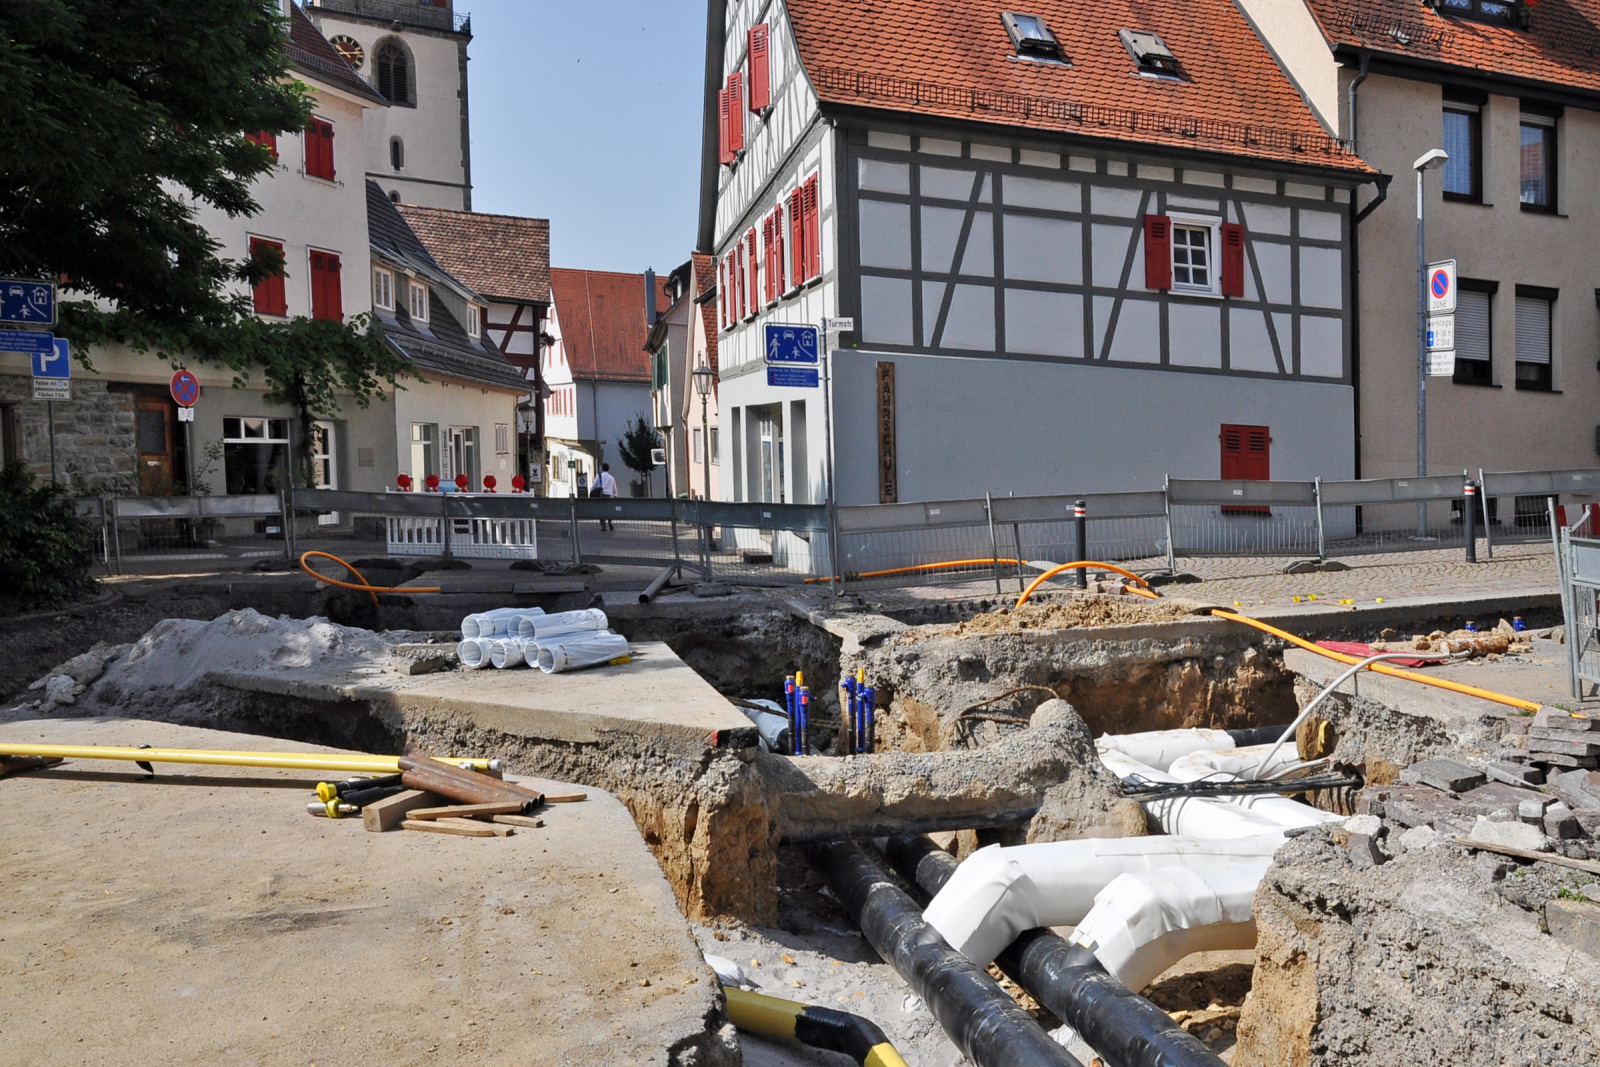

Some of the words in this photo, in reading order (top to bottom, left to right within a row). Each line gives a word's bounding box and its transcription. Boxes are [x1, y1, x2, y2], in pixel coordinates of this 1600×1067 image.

[1432, 300, 1447, 309] ZONE
[41, 344, 60, 372] P
[882, 369, 893, 496] FAHRSCHULE
